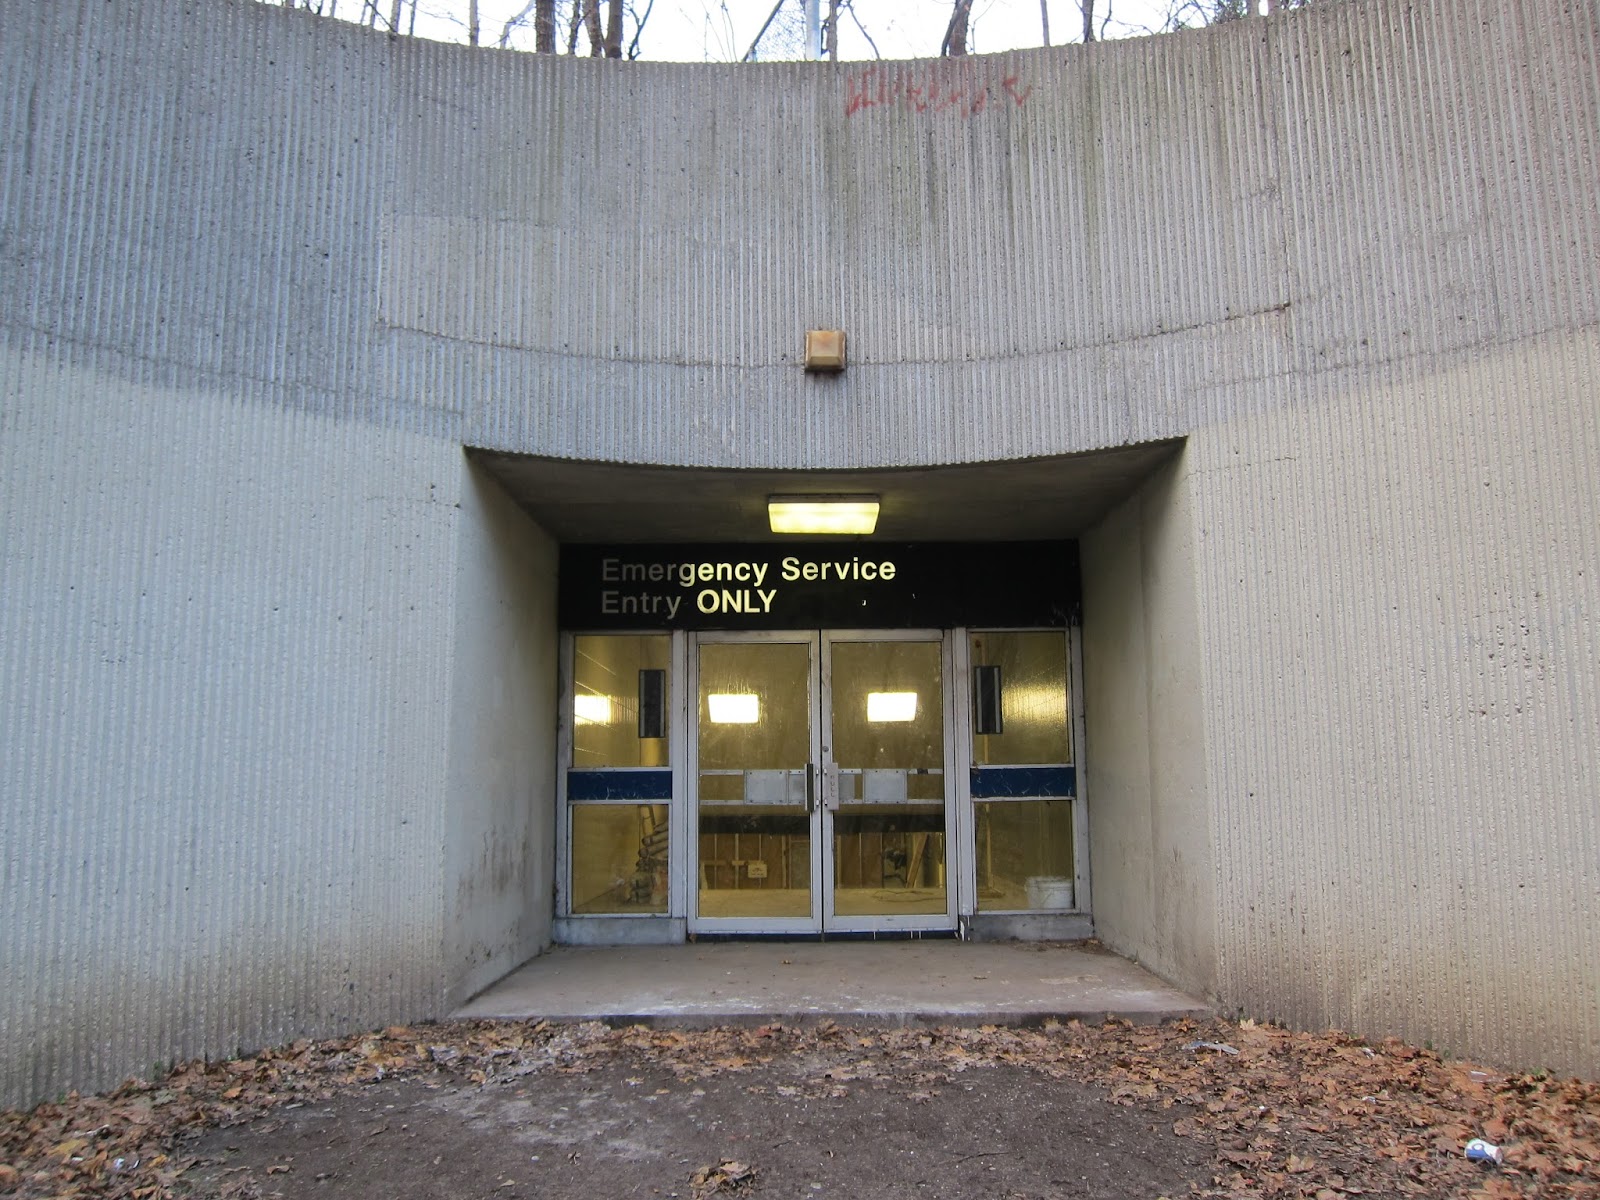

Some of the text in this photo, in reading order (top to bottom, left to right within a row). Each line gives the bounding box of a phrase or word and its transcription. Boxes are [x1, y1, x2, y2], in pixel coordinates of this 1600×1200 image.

[602, 556, 897, 588] Emergency Service
[602, 588, 777, 620] Entry ONLY
